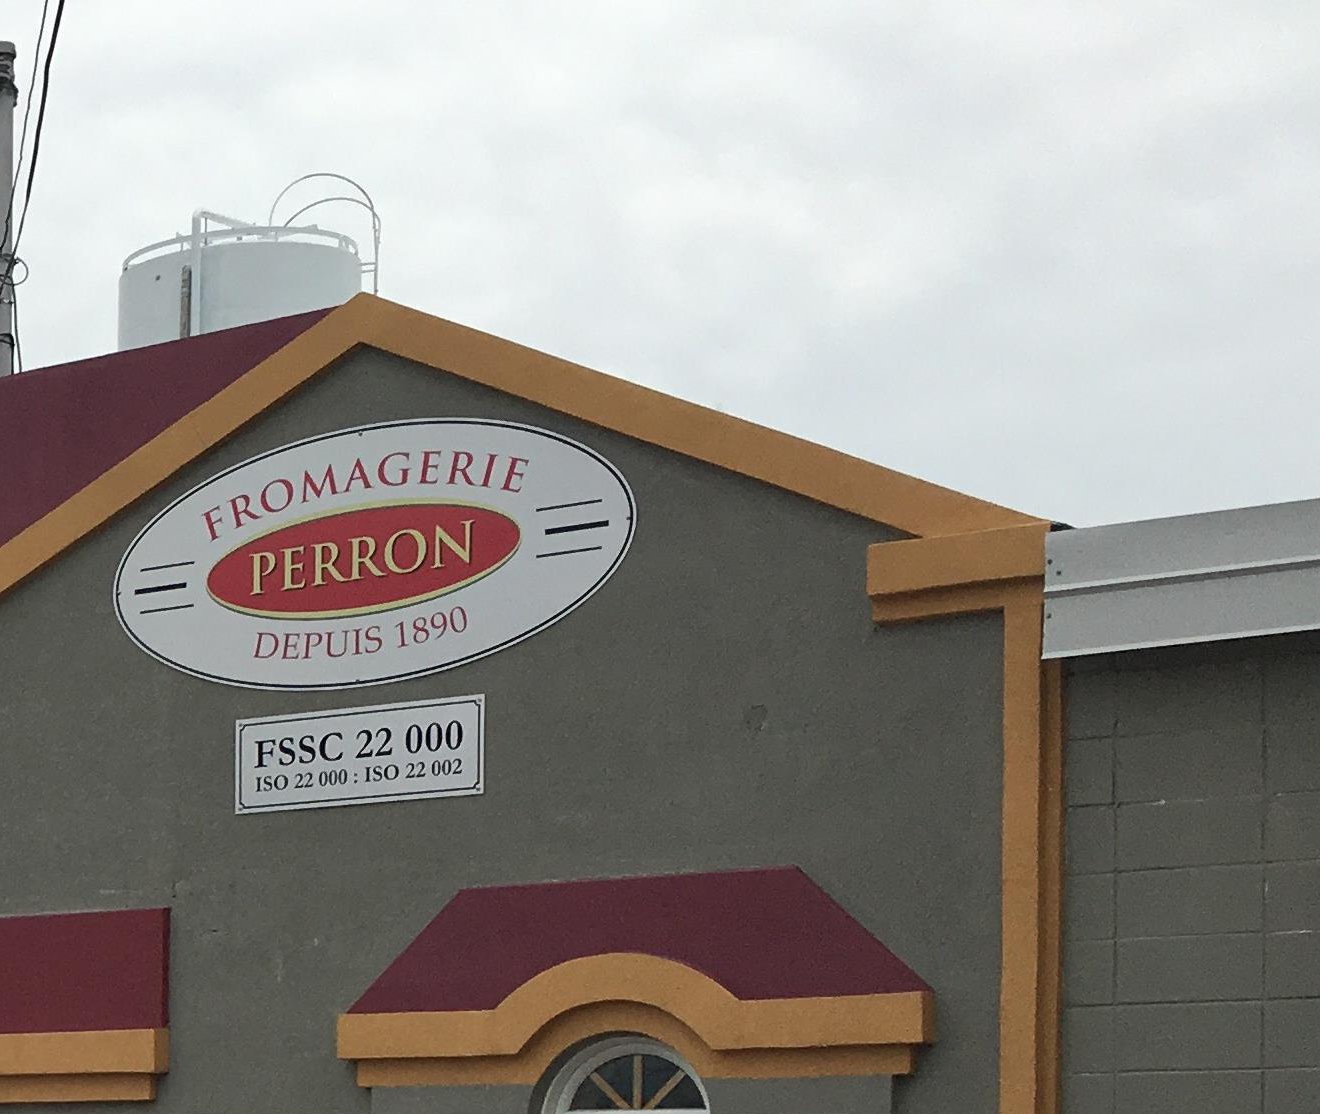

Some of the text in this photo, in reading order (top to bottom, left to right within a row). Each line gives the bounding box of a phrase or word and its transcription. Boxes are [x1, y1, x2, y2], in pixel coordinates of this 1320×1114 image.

[201, 450, 530, 542] FROMAGERIE
[249, 519, 476, 596] PERRON
[253, 605, 469, 660] DEPUIS 1890
[254, 719, 464, 769] FSSC 22 000
[255, 774, 289, 792] ISO
[294, 771, 315, 789] 22
[318, 768, 349, 786] 000
[364, 764, 399, 783] ISO
[405, 761, 427, 780] 22
[431, 758, 463, 777] 002
